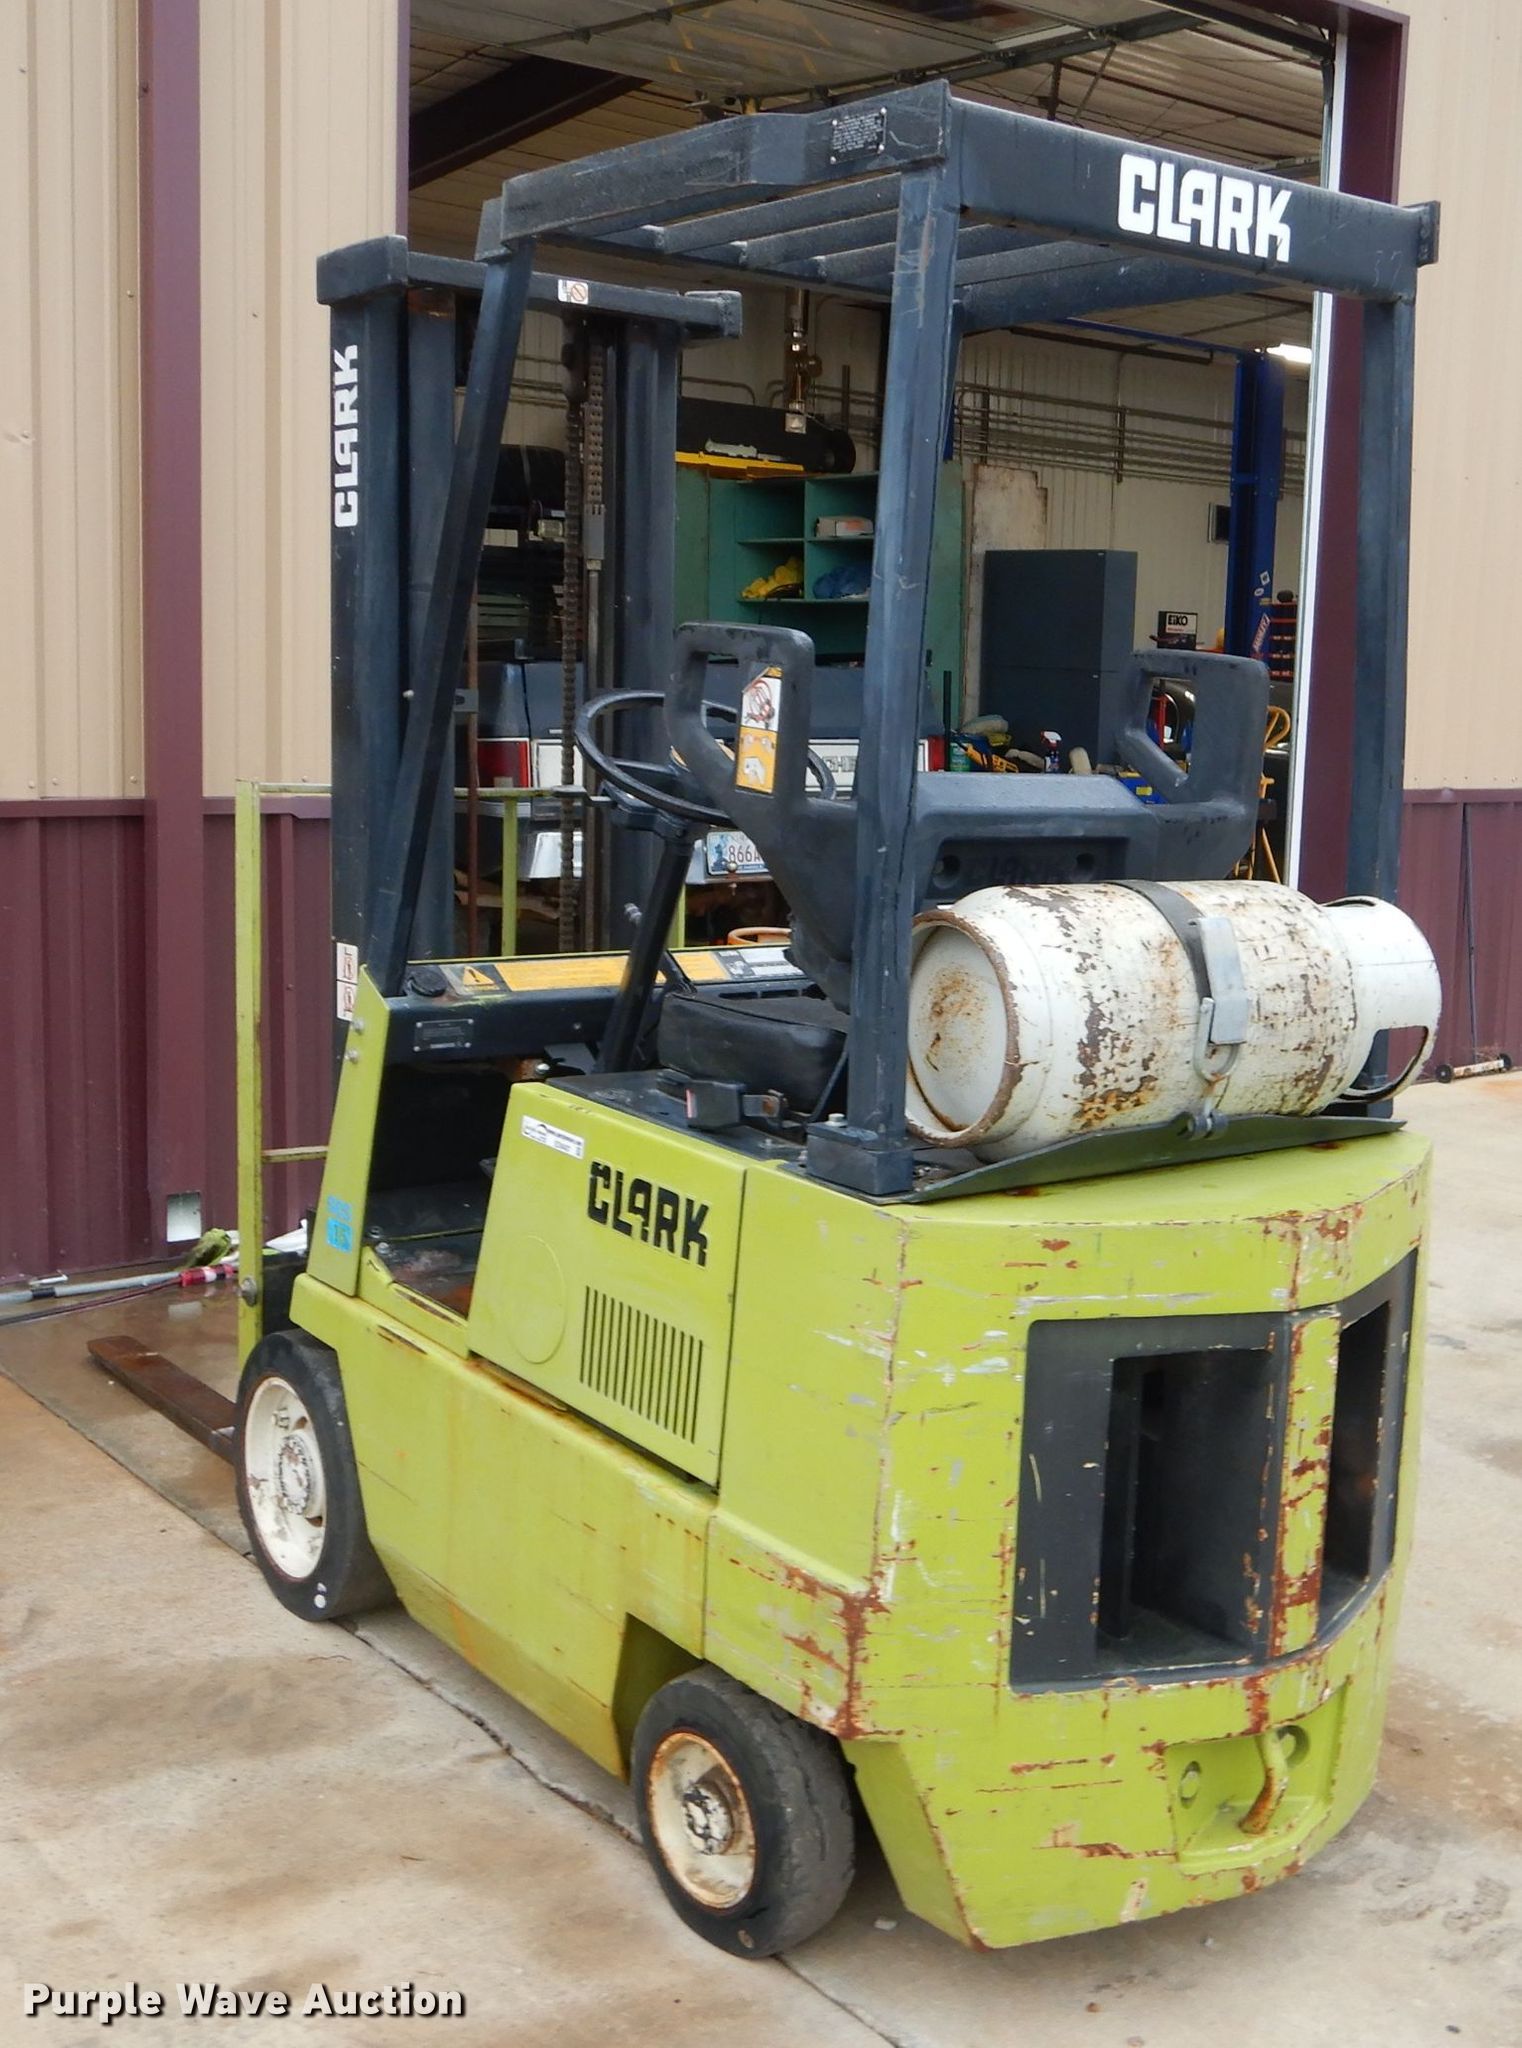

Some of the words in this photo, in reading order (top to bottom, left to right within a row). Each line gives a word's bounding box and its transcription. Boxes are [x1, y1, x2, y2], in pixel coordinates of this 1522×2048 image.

[1118, 154, 1292, 263] CLARK
[334, 345, 358, 527] CLARK
[588, 1161, 709, 1268] CLARK
